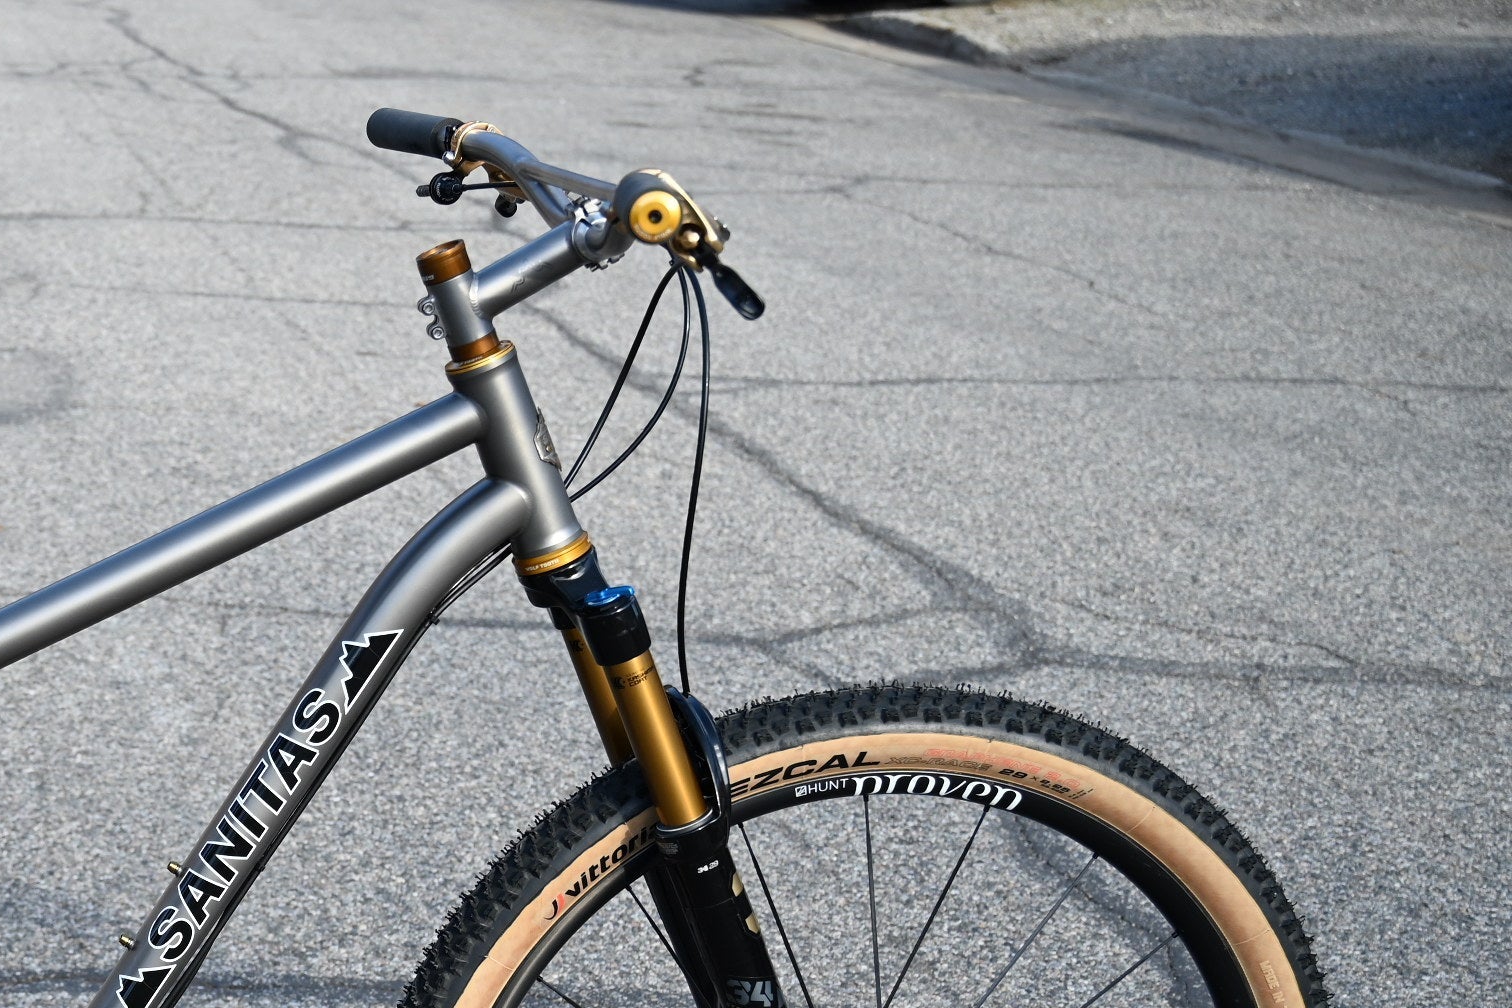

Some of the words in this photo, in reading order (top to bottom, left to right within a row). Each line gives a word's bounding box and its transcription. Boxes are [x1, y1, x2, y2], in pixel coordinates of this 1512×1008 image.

[540, 558, 561, 569] TOOTH
[730, 751, 881, 798] EZCAL
[886, 756, 993, 772] XC-RACE
[998, 767, 1028, 779] 29
[808, 778, 849, 795] HUNT
[851, 773, 1023, 811] proven
[148, 688, 342, 963] SANITAS
[726, 979, 775, 1008] 34
[1259, 960, 1279, 991] MADE
[1273, 991, 1284, 1003] IN
